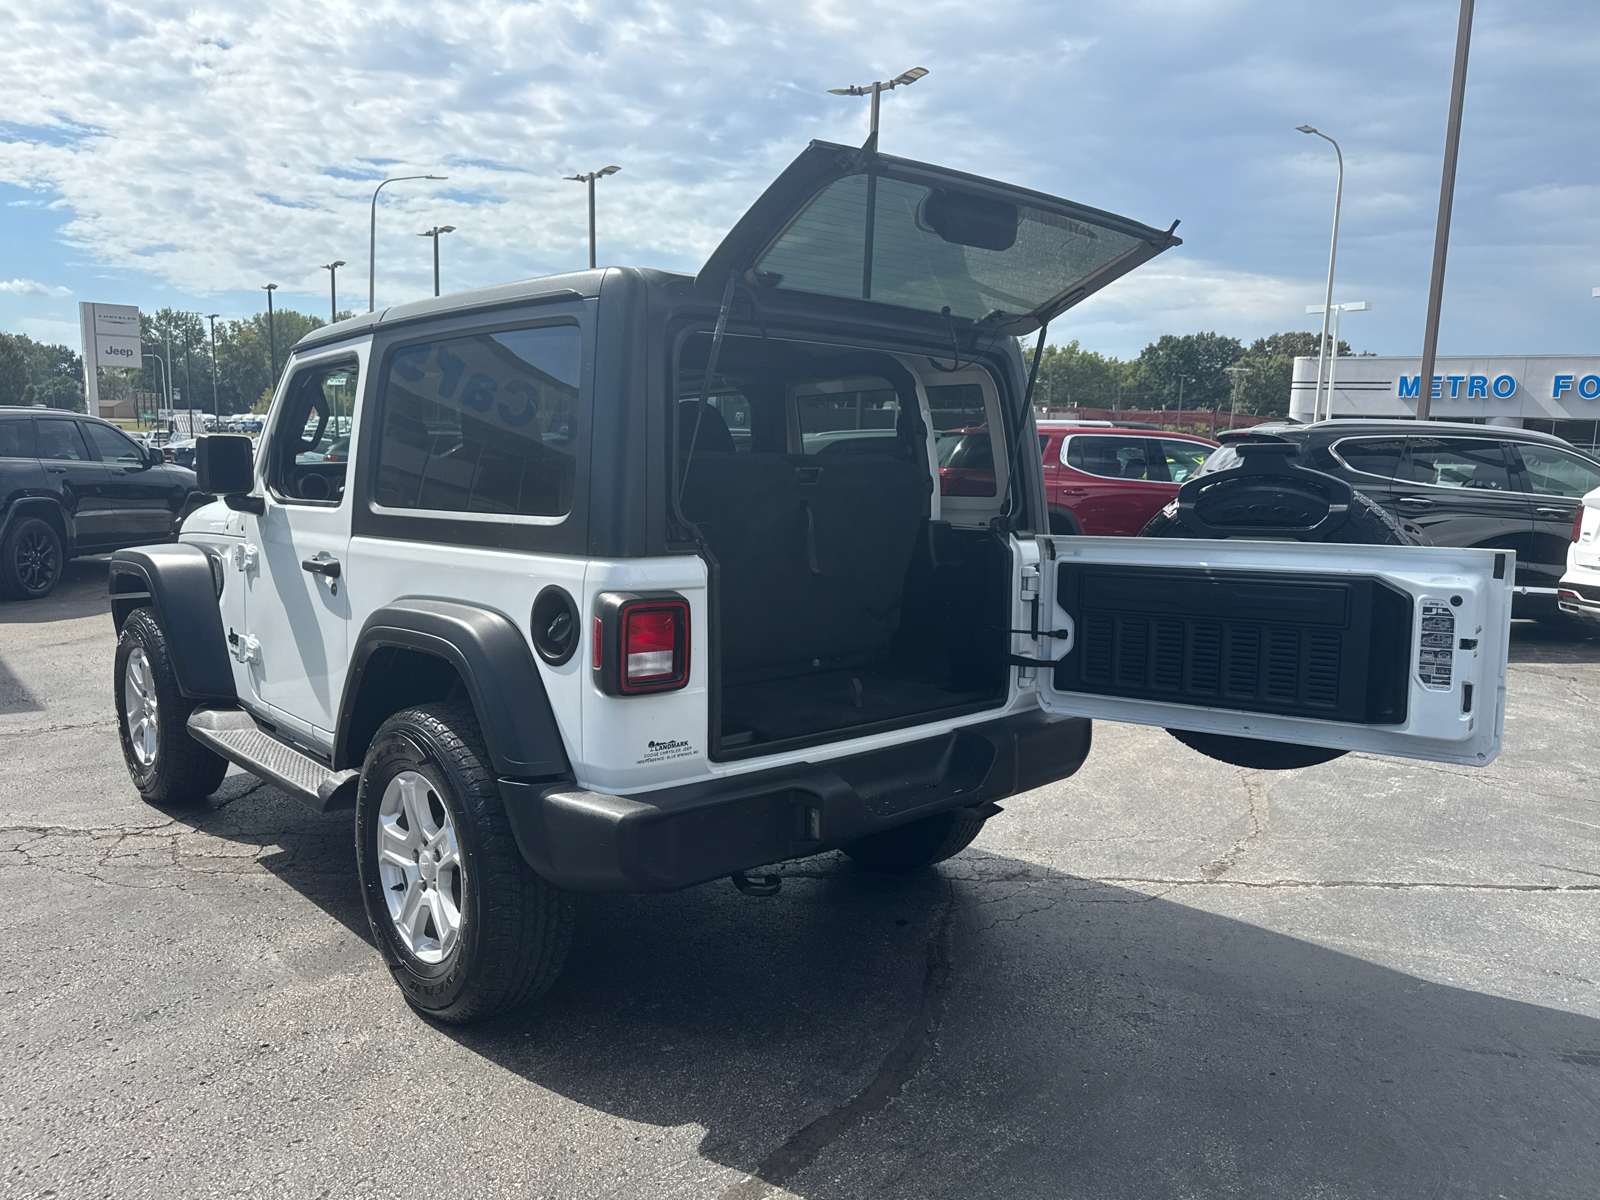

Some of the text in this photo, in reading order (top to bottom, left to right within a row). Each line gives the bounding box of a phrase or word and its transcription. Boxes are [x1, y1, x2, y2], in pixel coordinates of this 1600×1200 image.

[105, 345, 134, 358] Jeep
[1398, 374, 1517, 399] METRO
[655, 740, 689, 752] LANDMARK
[660, 748, 682, 756] CHRYSLER
